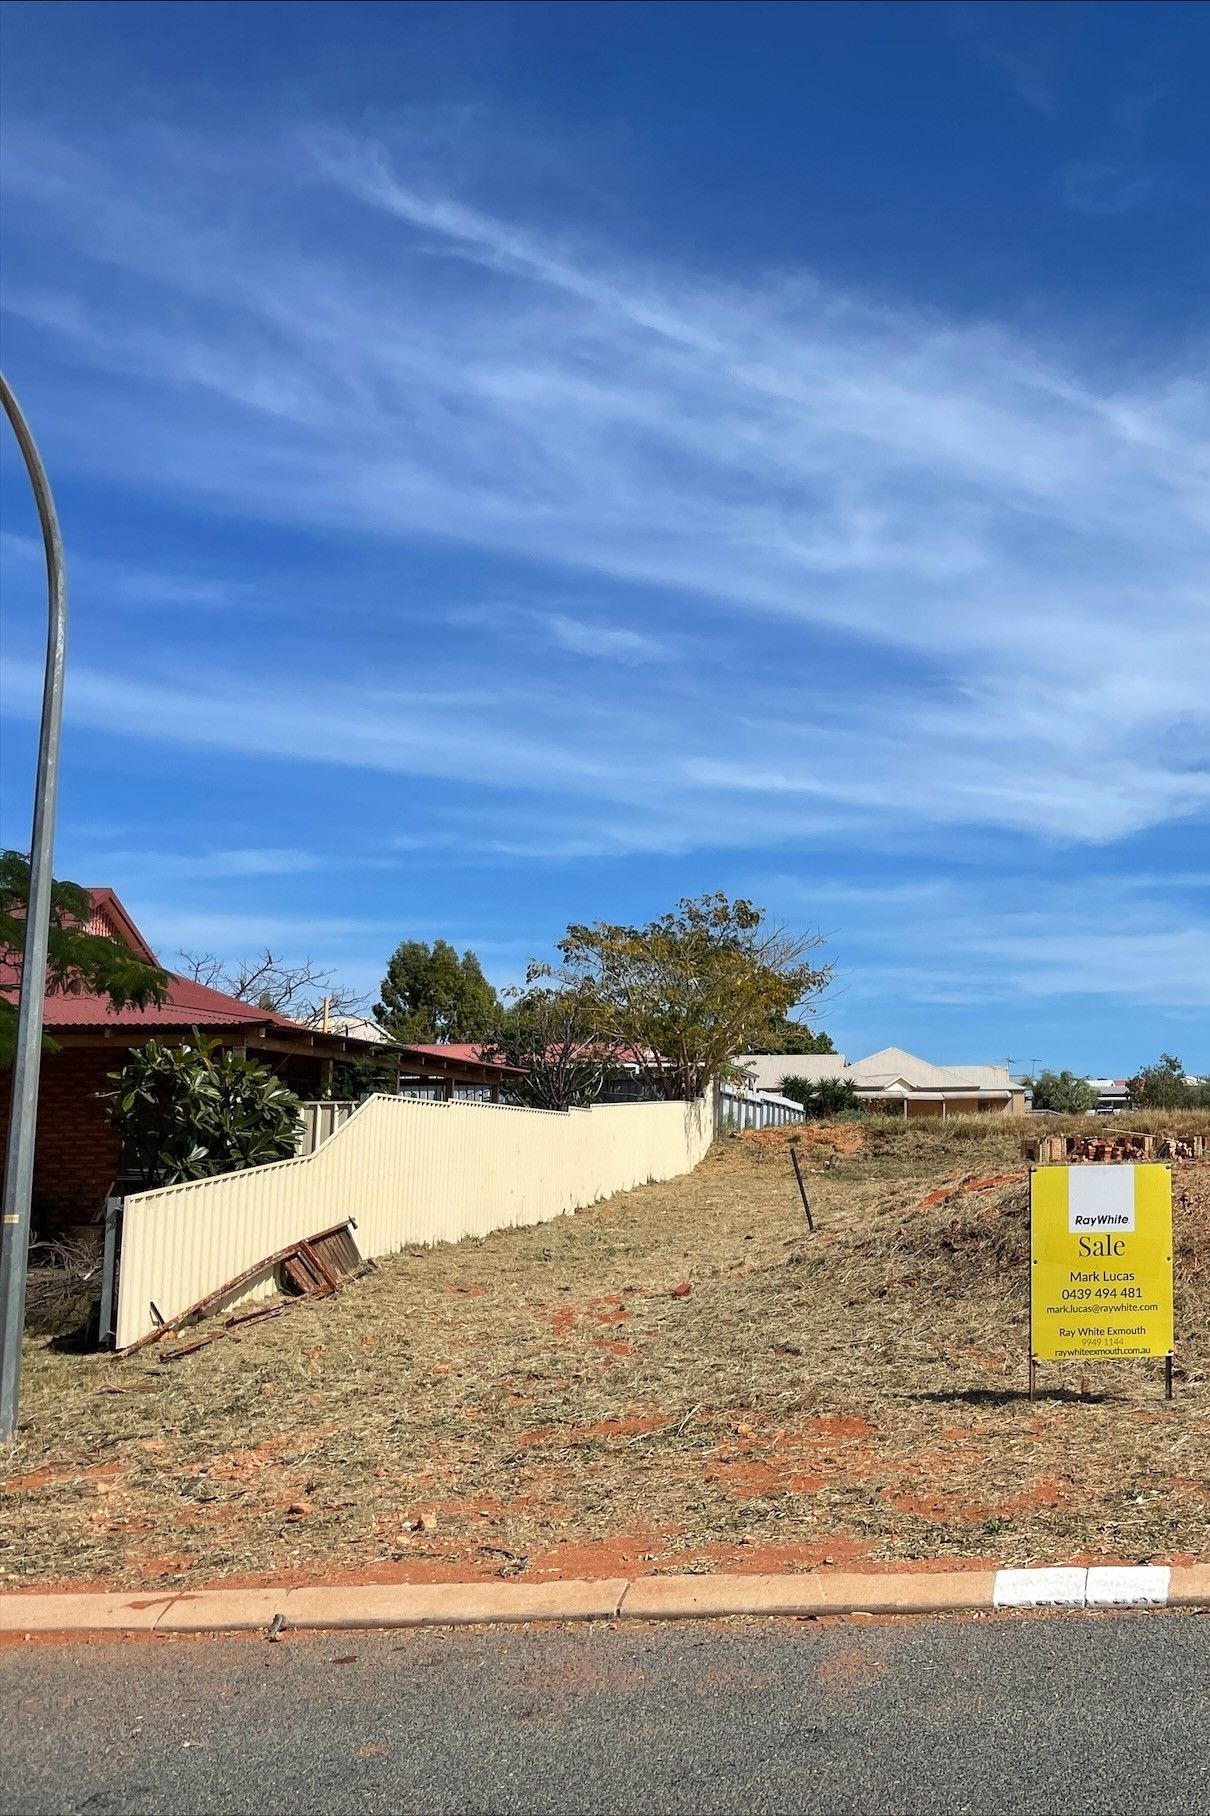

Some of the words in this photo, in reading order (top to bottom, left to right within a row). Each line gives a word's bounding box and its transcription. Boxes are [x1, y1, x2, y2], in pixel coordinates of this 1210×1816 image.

[1078, 1234, 1126, 1257] Sale
[1070, 1271, 1100, 1283] Mark
[1103, 1271, 1135, 1282] Lucas
[1062, 1288, 1092, 1300] 0439
[1095, 1288, 1117, 1299] 494
[1120, 1287, 1142, 1299] 481
[1046, 1302, 1158, 1314] mark.lucas@raywhite.com
[1059, 1328, 1076, 1338] Ray
[1078, 1326, 1105, 1337] White
[1107, 1325, 1146, 1336] Exmouth
[1081, 1339, 1102, 1347] 9949
[1104, 1338, 1125, 1347] 1144
[1055, 1347, 1151, 1357] raywhiteexmouth.com.au
